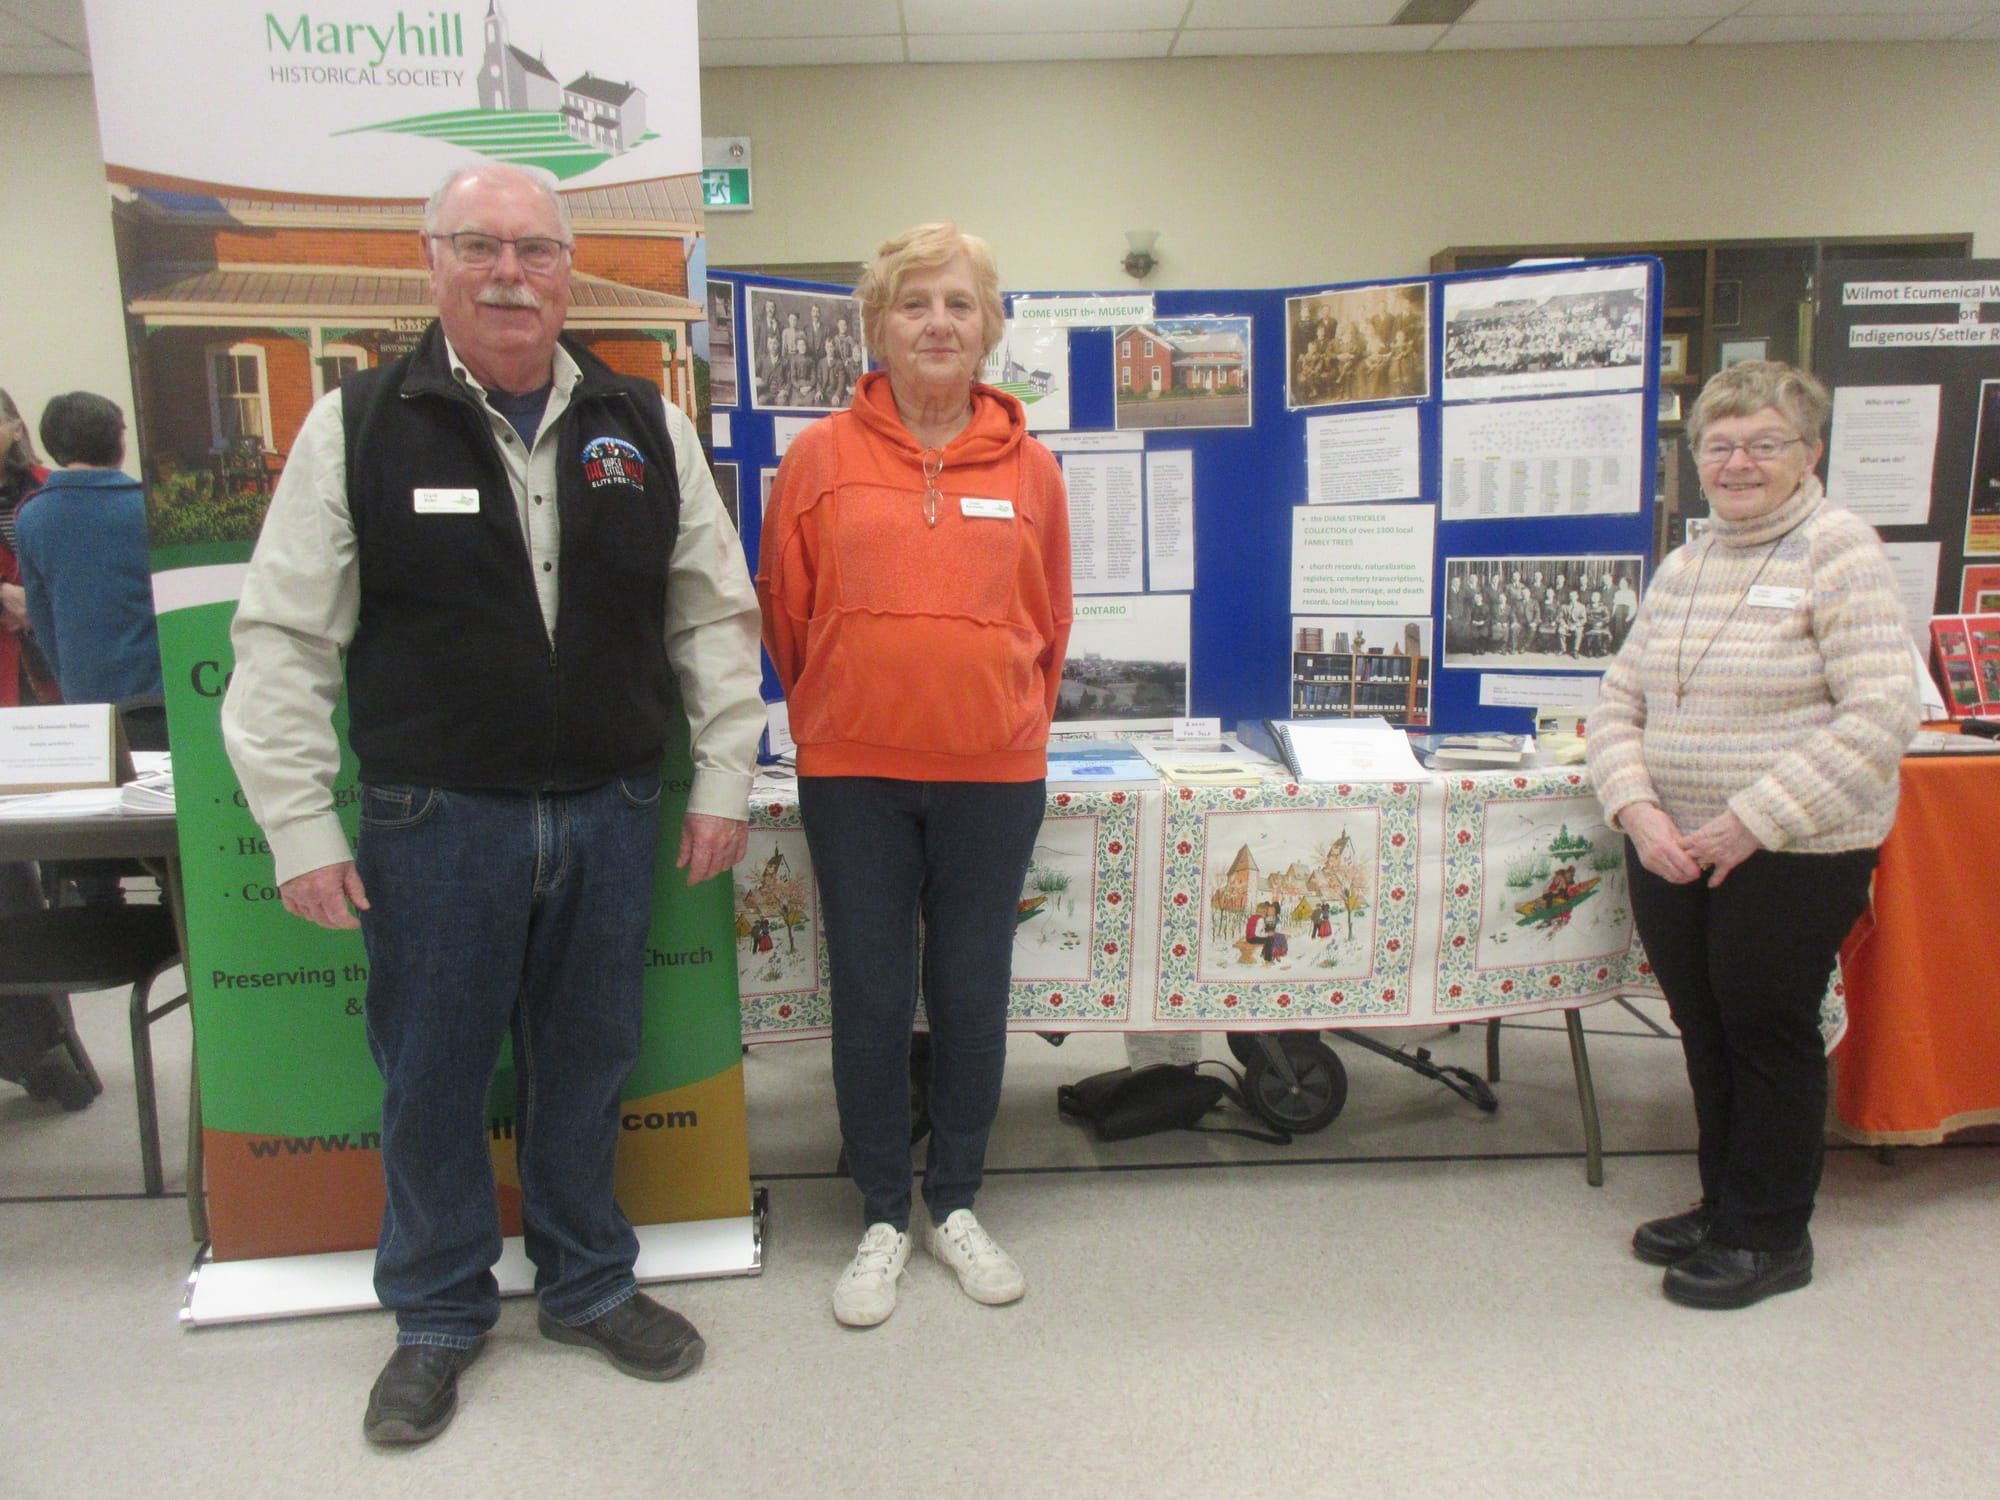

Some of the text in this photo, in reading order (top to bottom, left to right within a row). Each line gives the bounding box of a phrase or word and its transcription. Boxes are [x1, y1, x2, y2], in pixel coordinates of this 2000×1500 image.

[265, 11, 463, 67] Maryhill
[270, 66, 464, 86] HISTORICAL SOCIETY
[1844, 287, 1899, 300] Wilmot
[1903, 284, 1985, 300] Ecumenical
[1022, 310, 1051, 319] COME
[1054, 309, 1078, 318] VISIT
[1098, 306, 1144, 317] MUSEUM
[1959, 310, 1978, 320] on
[1850, 327, 1986, 345] Indigenous/Settler
[1082, 606, 1126, 616] ONTARIO
[237, 837, 271, 855] He
[212, 964, 368, 988] Preserving th
[345, 998, 364, 1016] &
[621, 1108, 698, 1131] com
